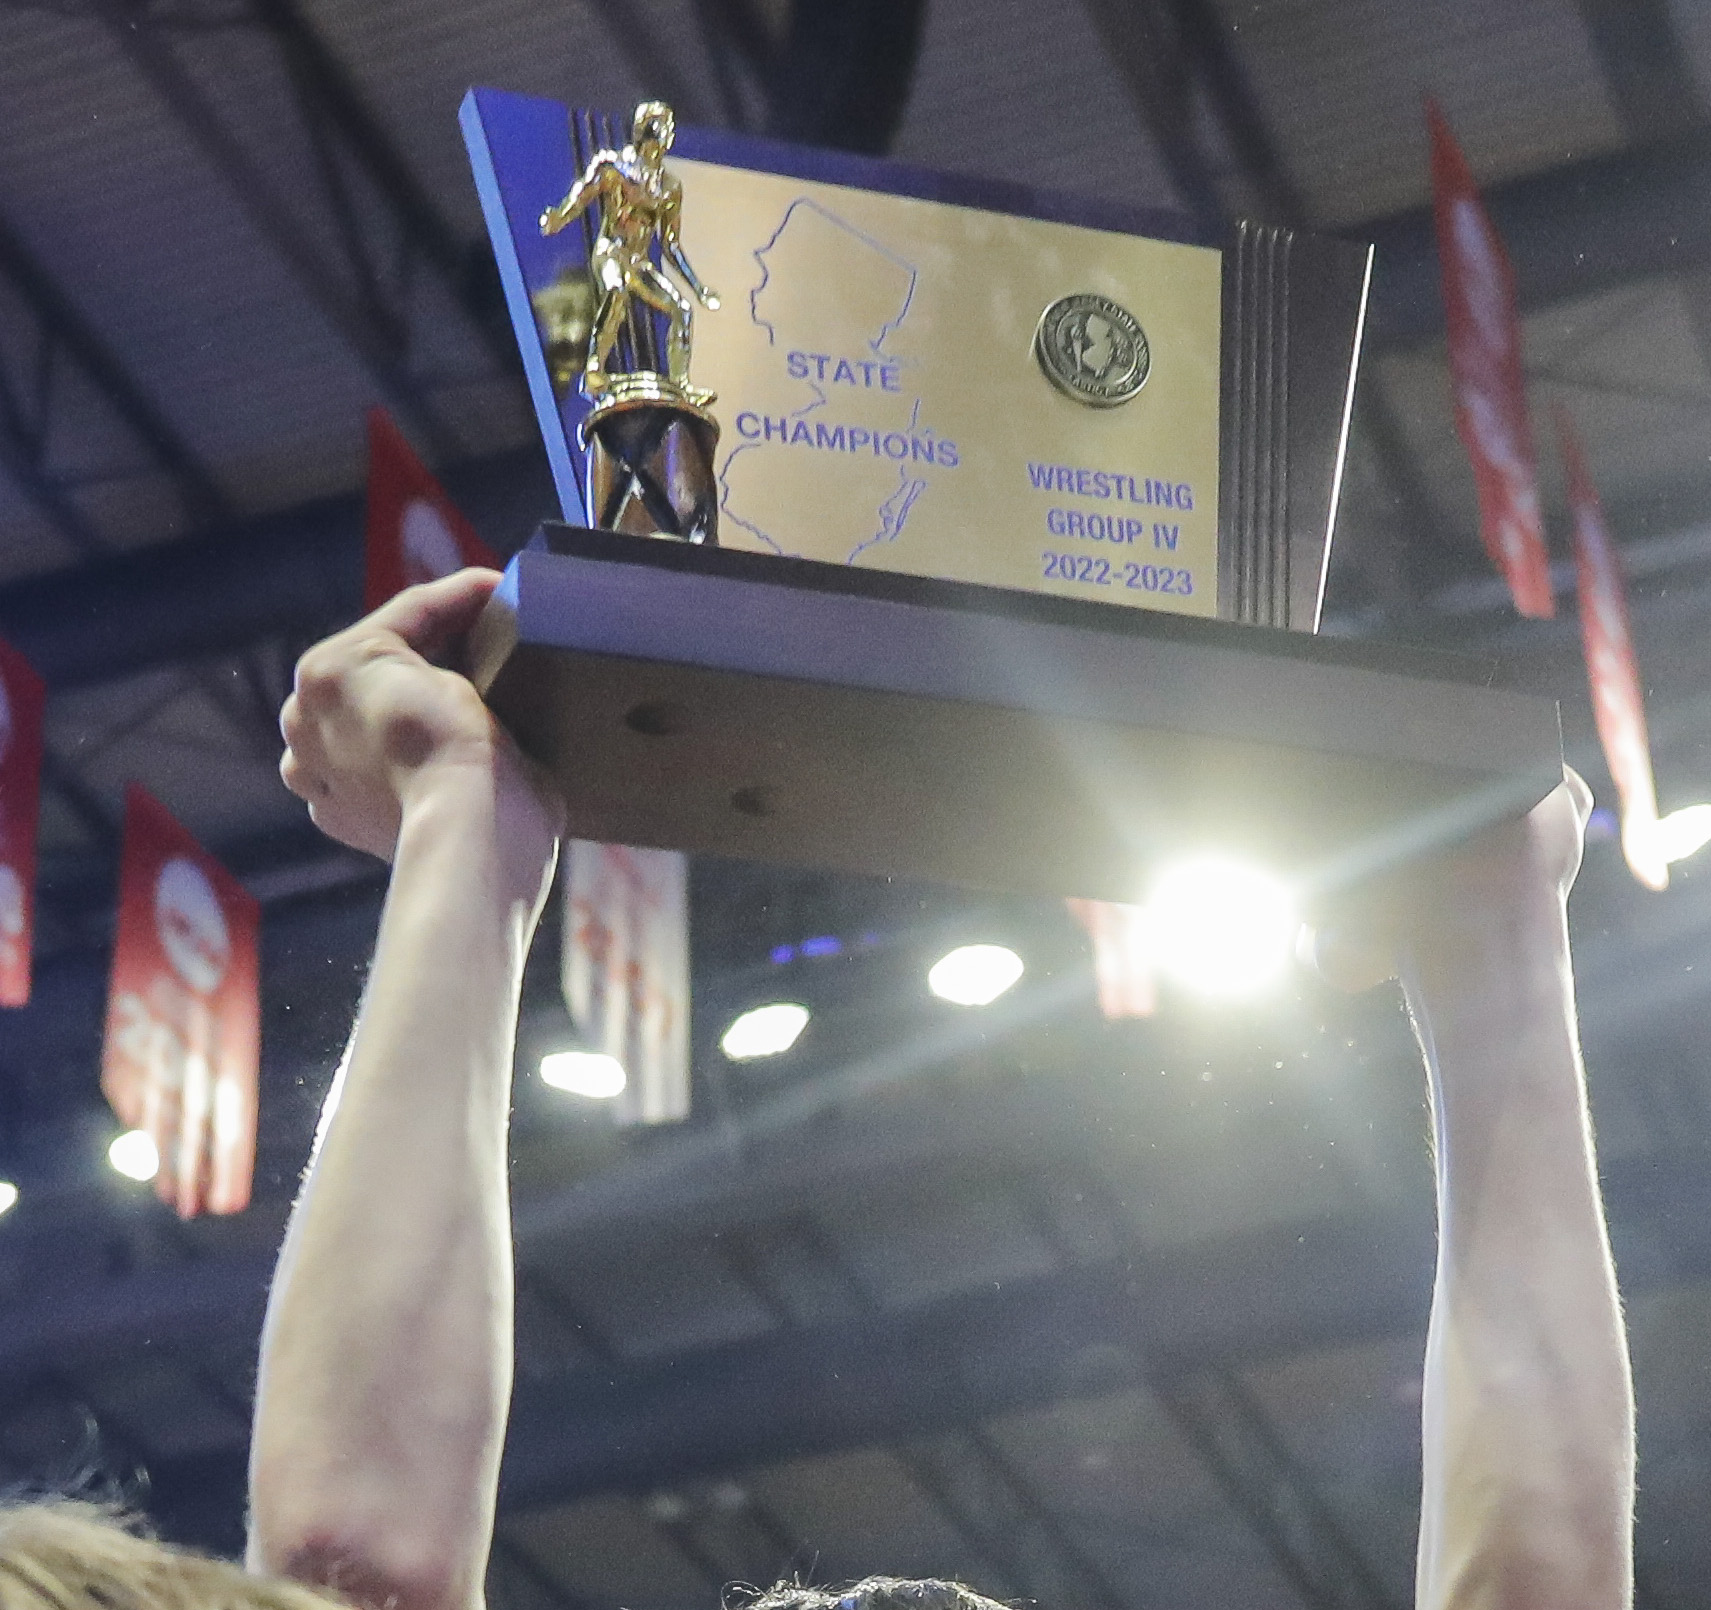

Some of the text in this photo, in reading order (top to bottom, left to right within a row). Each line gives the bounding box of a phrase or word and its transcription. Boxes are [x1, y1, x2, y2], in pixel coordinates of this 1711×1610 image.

[787, 351, 901, 393] STATE
[736, 411, 959, 468] CHAMPIONS
[1027, 462, 1195, 511] WRESTLING
[1047, 507, 1179, 551] GROUP IV
[1041, 551, 1194, 597] 2022-2023
